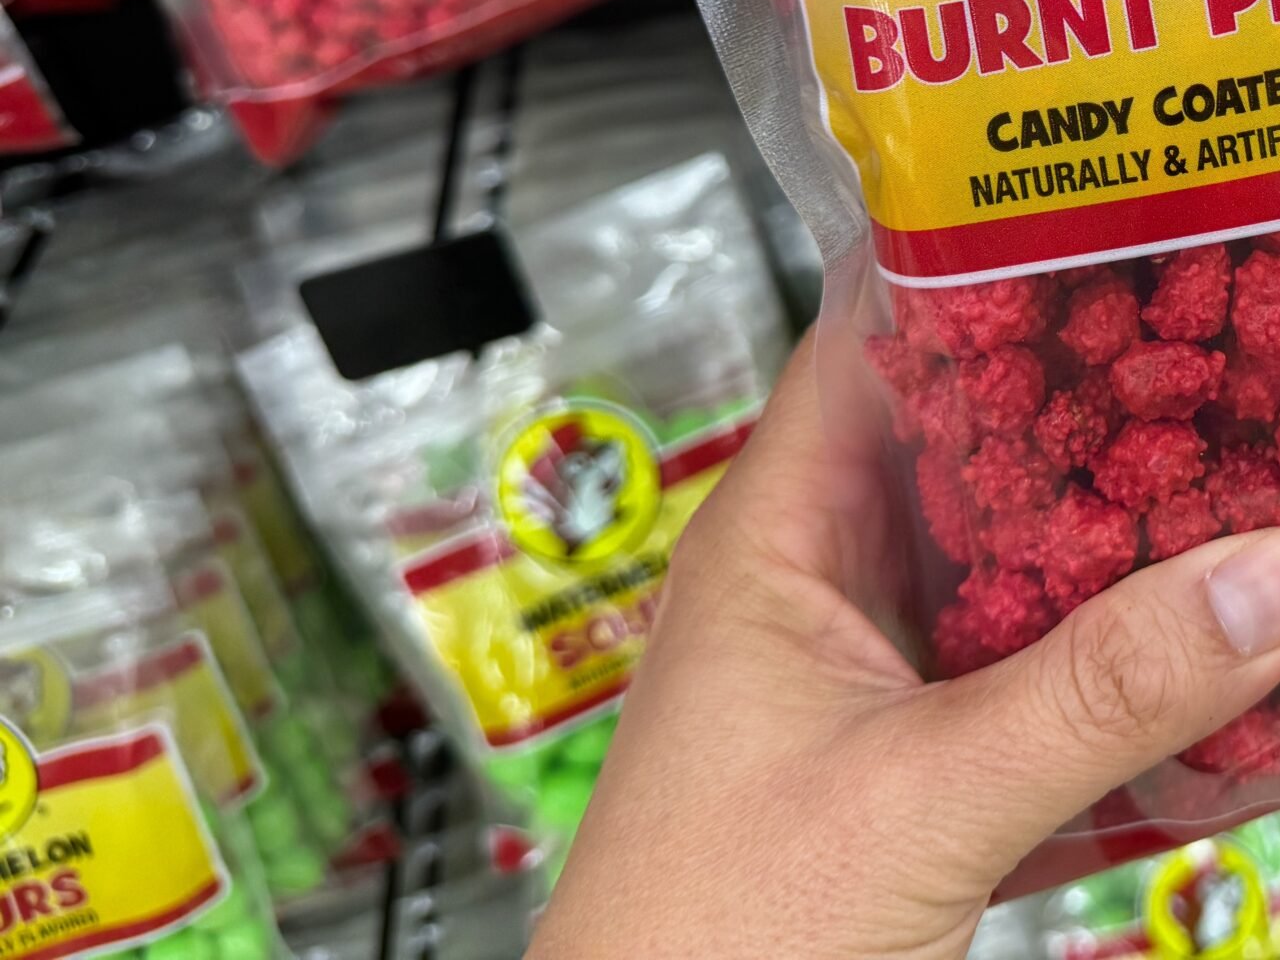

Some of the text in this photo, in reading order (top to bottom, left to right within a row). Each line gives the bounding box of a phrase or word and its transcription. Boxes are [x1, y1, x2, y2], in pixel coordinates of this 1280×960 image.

[986, 96, 1135, 153] CANDY
[969, 149, 1152, 208] NATURALLY
[1163, 144, 1189, 177] &
